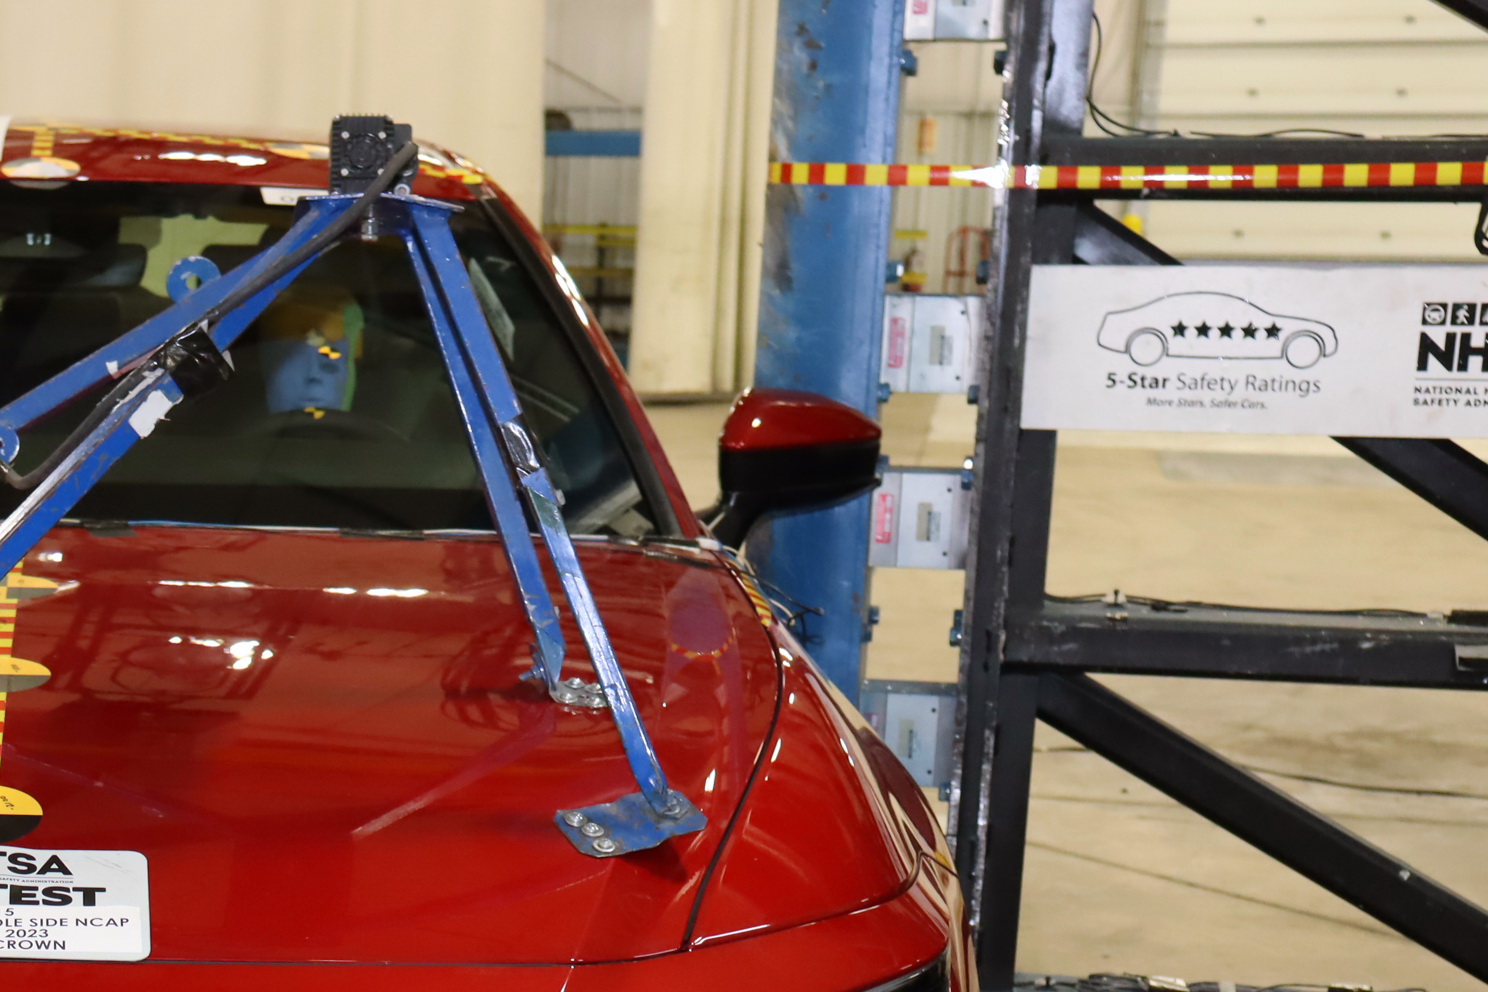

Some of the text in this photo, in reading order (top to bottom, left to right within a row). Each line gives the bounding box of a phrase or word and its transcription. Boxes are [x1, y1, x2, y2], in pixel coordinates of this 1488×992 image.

[1106, 372, 1321, 398] 5-Star Safety Ratings
[1413, 385, 1479, 396] NATIONAL
[1146, 397, 1174, 408] More
[1413, 398, 1459, 408] SAFETY
[29, 917, 69, 928] SIDE
[75, 917, 130, 928] NCAP
[5, 929, 49, 938] 2023
